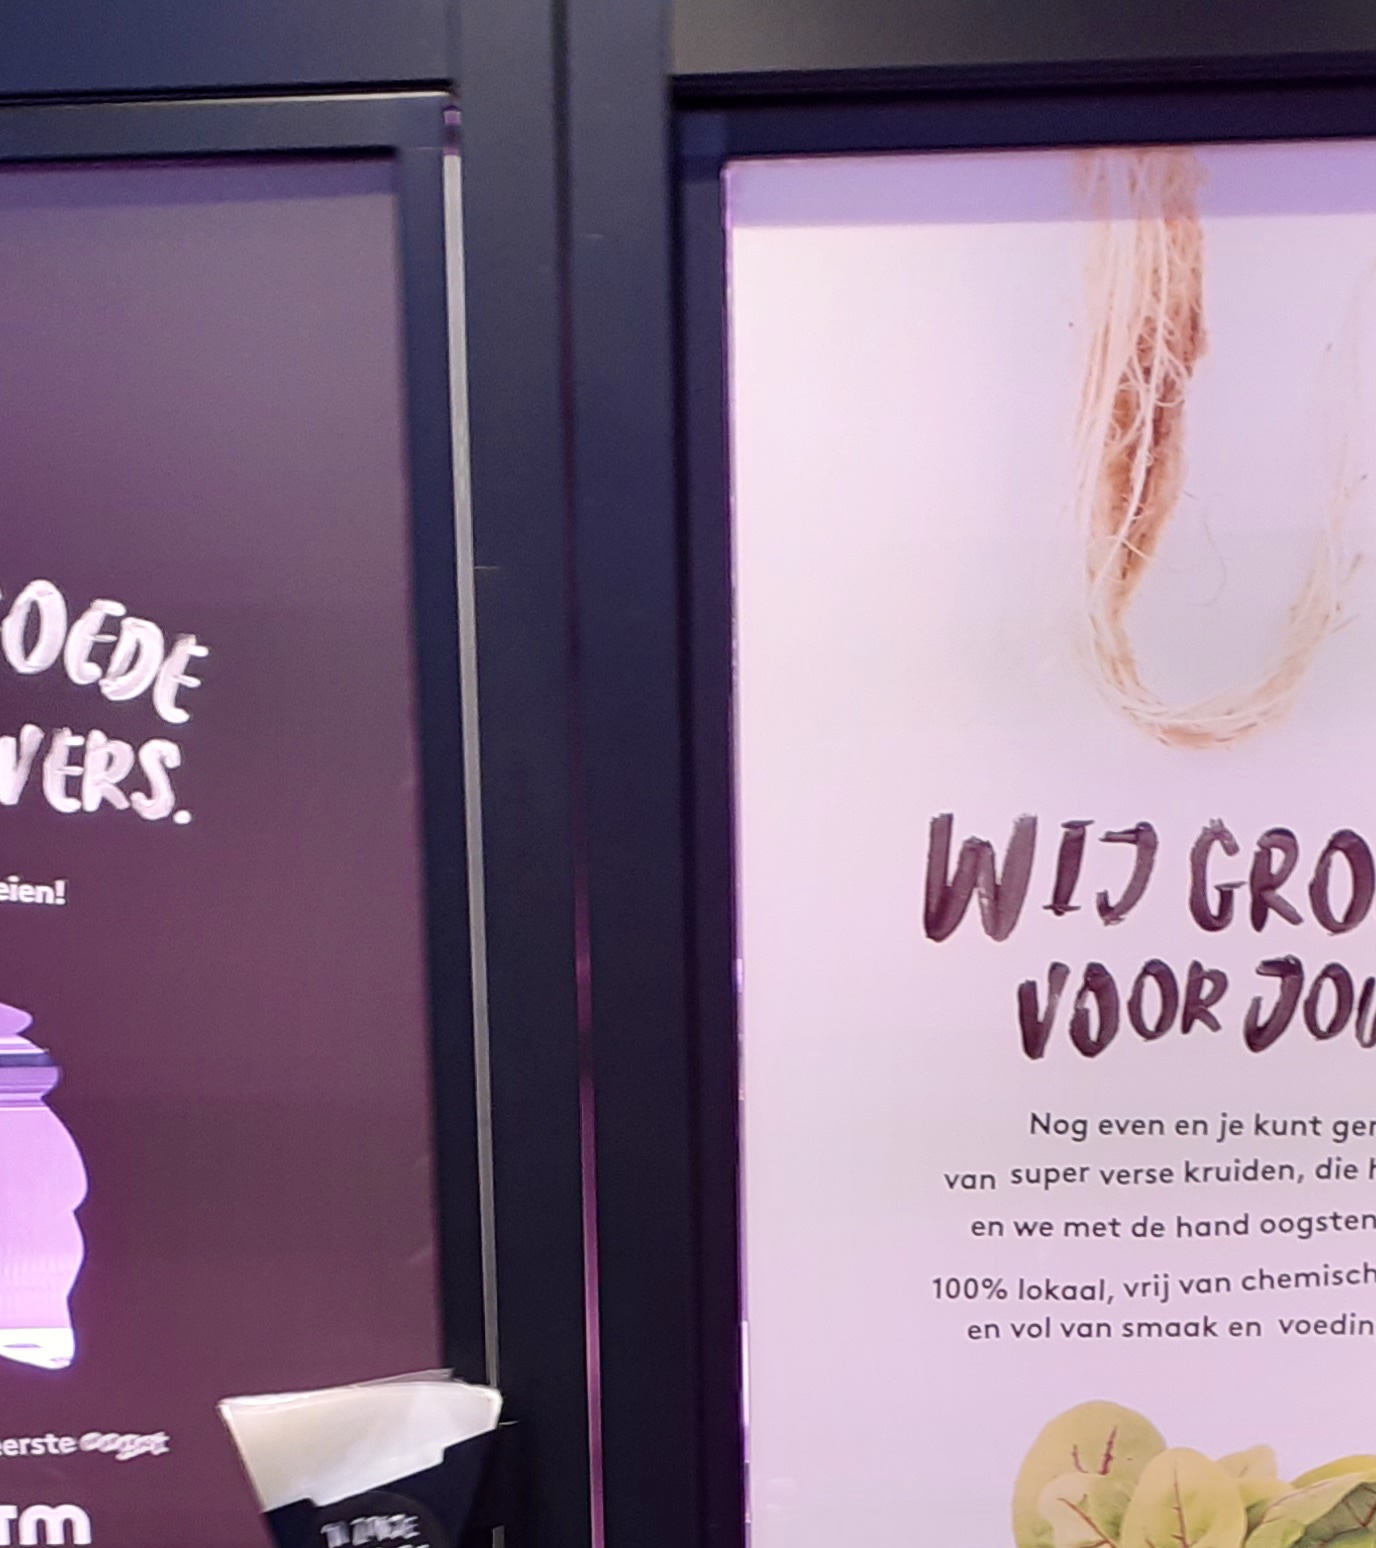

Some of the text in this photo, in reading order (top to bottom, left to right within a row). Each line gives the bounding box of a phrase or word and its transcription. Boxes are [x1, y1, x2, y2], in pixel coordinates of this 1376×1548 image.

[922, 813, 1159, 943] WIJ
[1017, 958, 1229, 1061] VOOR
[1030, 1112, 1088, 1143] Nog
[1098, 1119, 1165, 1136] even
[1174, 1119, 1208, 1136] en
[1216, 1112, 1244, 1144] je
[1254, 1113, 1323, 1137] kunt
[943, 1173, 996, 1190] van
[1010, 1166, 1090, 1191] super
[1099, 1167, 1174, 1185] verse
[1184, 1158, 1304, 1184] kruiden,
[1315, 1156, 1359, 1180] die
[971, 1220, 1004, 1237] en
[1013, 1221, 1054, 1238] we
[1063, 1217, 1122, 1238] met
[1131, 1215, 1165, 1238] de
[1176, 1212, 1249, 1238] hand
[932, 1277, 1008, 1300] 100%
[1018, 1278, 1114, 1305] lokaal,
[1123, 1273, 1169, 1304] vrij
[1178, 1277, 1231, 1295] van
[967, 1323, 1000, 1341] en
[1010, 1316, 1051, 1339] vol
[1060, 1322, 1112, 1338] van
[1122, 1315, 1219, 1338] smaak
[1228, 1321, 1262, 1337] en
